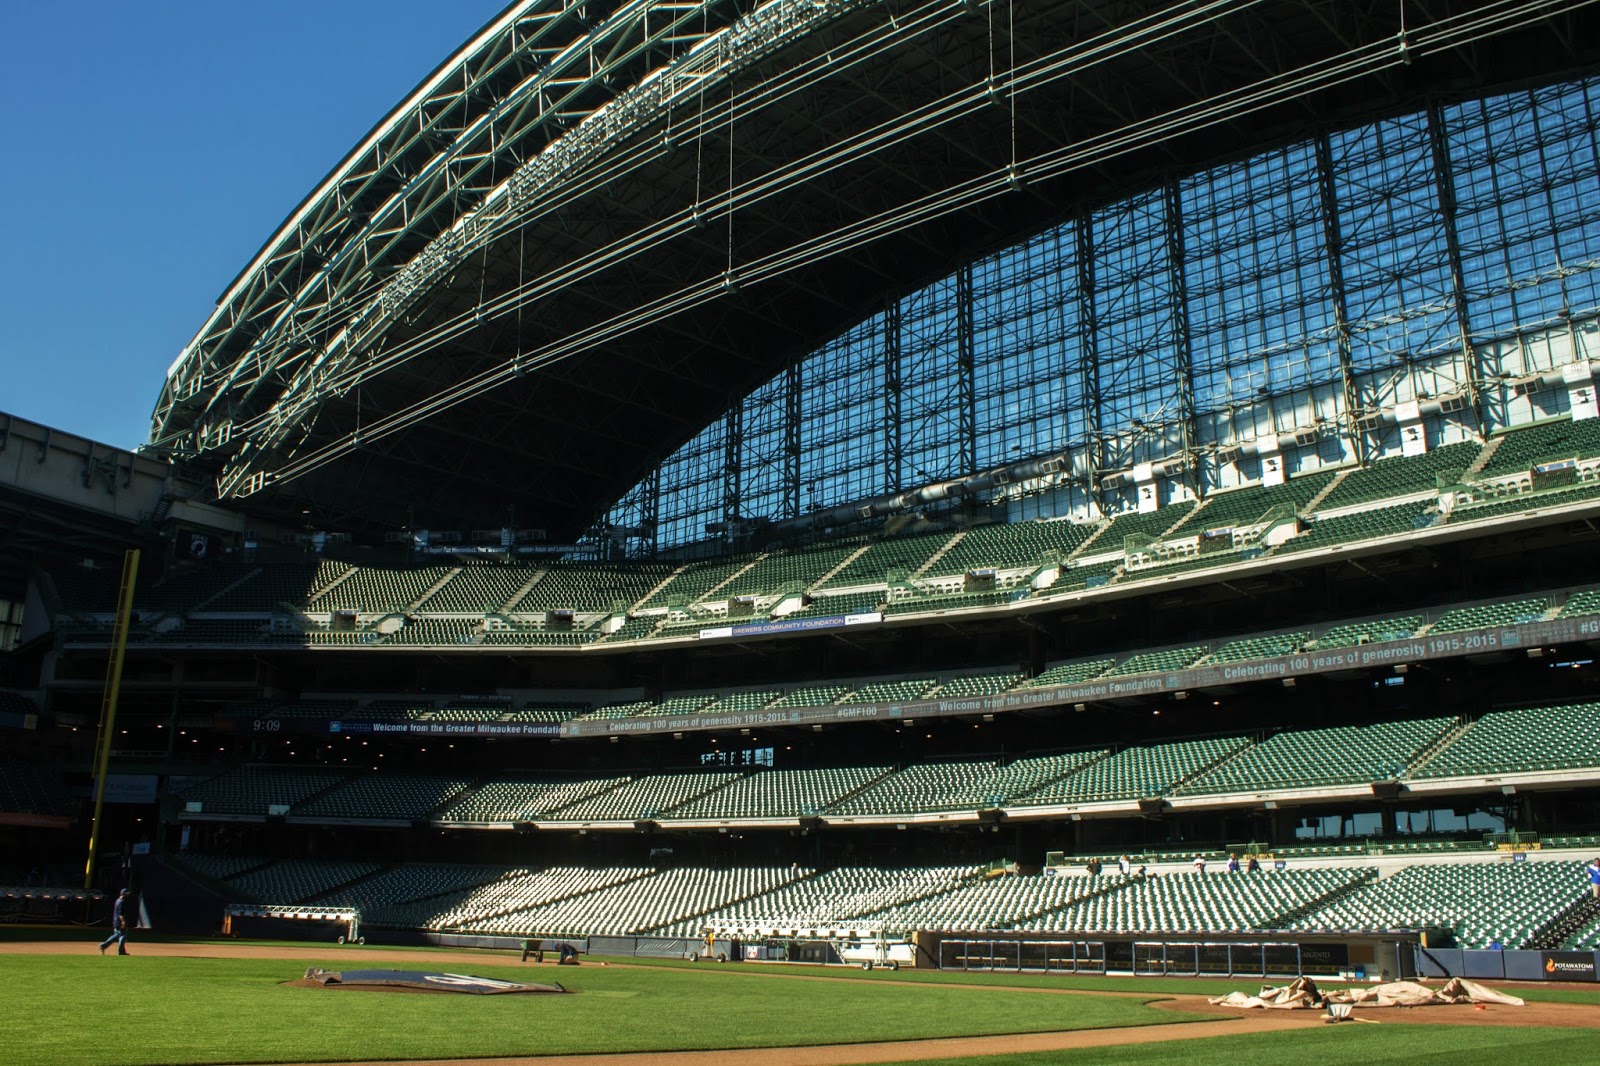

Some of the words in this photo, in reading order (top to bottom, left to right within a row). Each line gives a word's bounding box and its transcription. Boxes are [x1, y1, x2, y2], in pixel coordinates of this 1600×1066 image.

[733, 626, 762, 634] BREWERS
[763, 622, 801, 632] COMMUNITY
[802, 618, 845, 627] FOUNDATION
[1580, 620, 1600, 634] #G
[1224, 661, 1285, 679] Celebrating
[1289, 657, 1309, 670] 100
[1312, 655, 1344, 670] years
[1347, 651, 1358, 663] of
[1362, 643, 1426, 664] generosity
[1429, 633, 1497, 653] 1915-2015
[940, 700, 981, 711] Welcome
[984, 698, 1005, 708] from
[1006, 695, 1021, 705] the
[1023, 692, 1055, 704] Greater
[1057, 684, 1107, 700] Milwaukee
[1109, 678, 1162, 693] Foundation
[837, 706, 877, 718] #GMF100
[253, 719, 281, 731] 9:09
[373, 723, 408, 732] Welcome
[410, 723, 429, 732] from
[430, 723, 443, 732] the
[445, 724, 475, 733] Greater
[477, 724, 521, 733] Milwaukee
[523, 725, 567, 734] Foundation
[609, 720, 651, 732] Celebrating
[653, 719, 667, 729] 100
[668, 719, 689, 730] years
[691, 717, 700, 727] of
[701, 715, 743, 728] generosity
[744, 712, 787, 723] 1915-2015
[1301, 951, 1331, 959] ARGENTO
